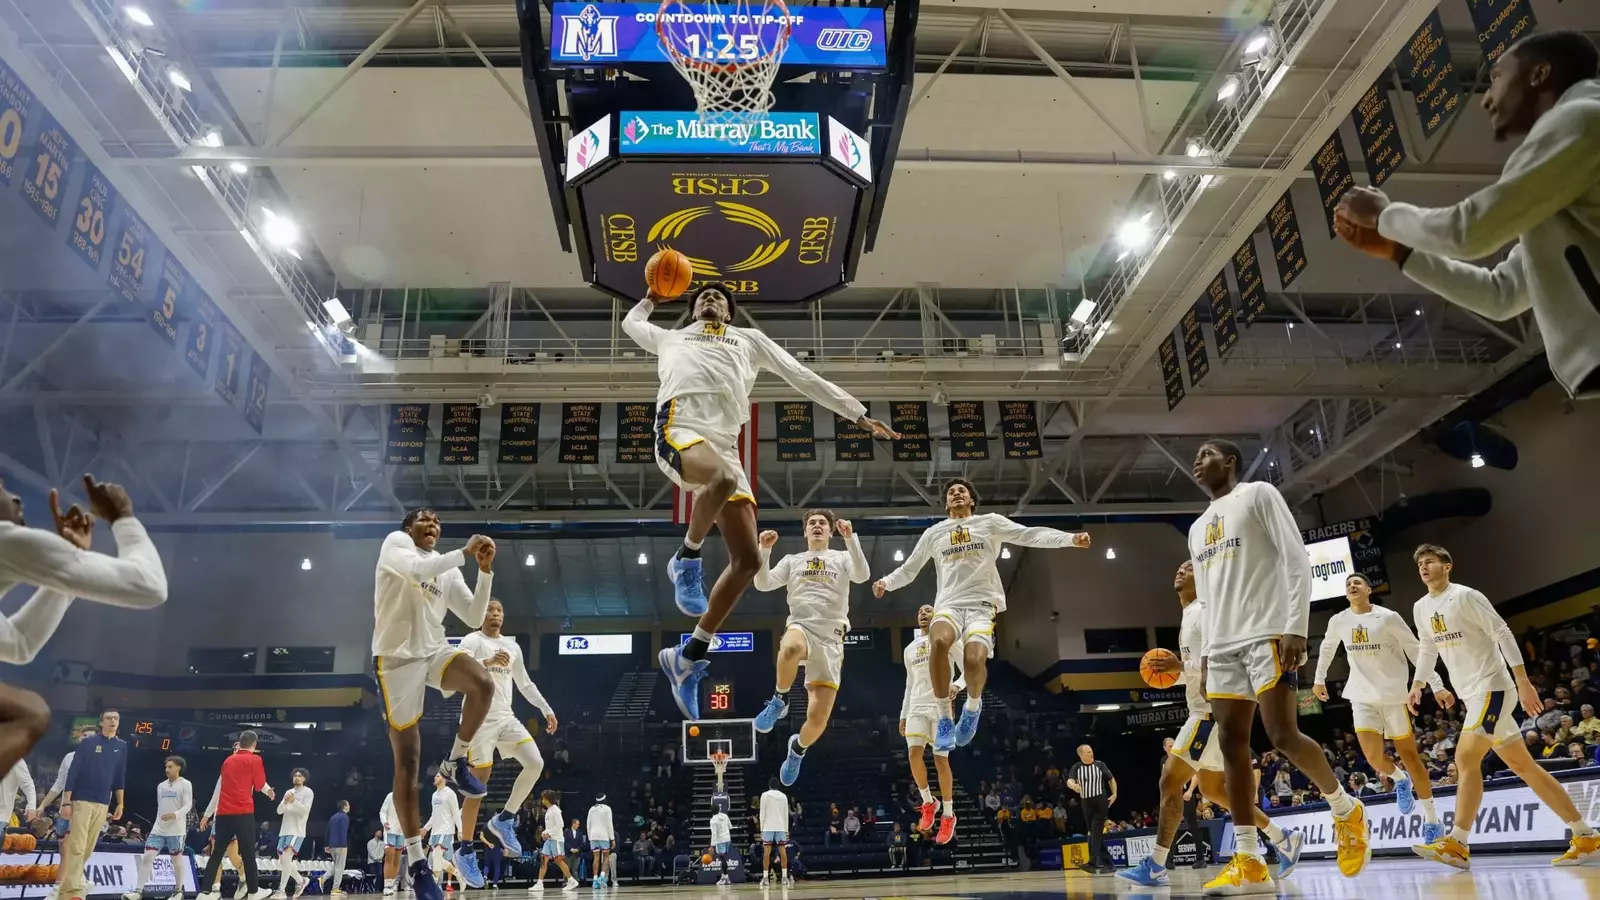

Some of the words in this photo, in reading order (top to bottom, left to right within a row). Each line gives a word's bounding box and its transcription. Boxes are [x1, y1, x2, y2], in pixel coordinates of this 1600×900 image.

[635, 13, 725, 24] COUNTDOWN
[730, 14, 748, 24] TO
[752, 15, 804, 26] TIP-OFF
[685, 33, 759, 60] 1:25
[817, 28, 873, 51] UIC
[1413, 34, 1433, 59] STATE
[651, 123, 674, 136] The
[676, 119, 753, 146] Murray
[760, 119, 816, 140] Bank
[1366, 121, 1395, 157] HAMPIONS
[36, 152, 61, 198] 15
[672, 178, 770, 196] CFSB
[76, 197, 104, 246] 30
[608, 213, 638, 263] CFSB
[798, 216, 829, 265] CFSB
[118, 231, 144, 279] 54
[162, 287, 176, 321] 5
[564, 416, 598, 425] UNIVERSITY
[1308, 520, 1356, 541] RACERS
[941, 546, 966, 557] MURRAY
[967, 542, 985, 551] STATE
[1311, 559, 1347, 582] rogram
[1444, 631, 1463, 641] STATE
[711, 694, 728, 710] 30
[208, 712, 272, 720] Concessions
[1126, 710, 1166, 726] MURRAY
[1167, 707, 1190, 721] STAT
[161, 738, 170, 750] 0
[1443, 803, 1540, 834] BYANT
[1177, 843, 1197, 853] SERVPR
[152, 858, 173, 870] BRYAN
